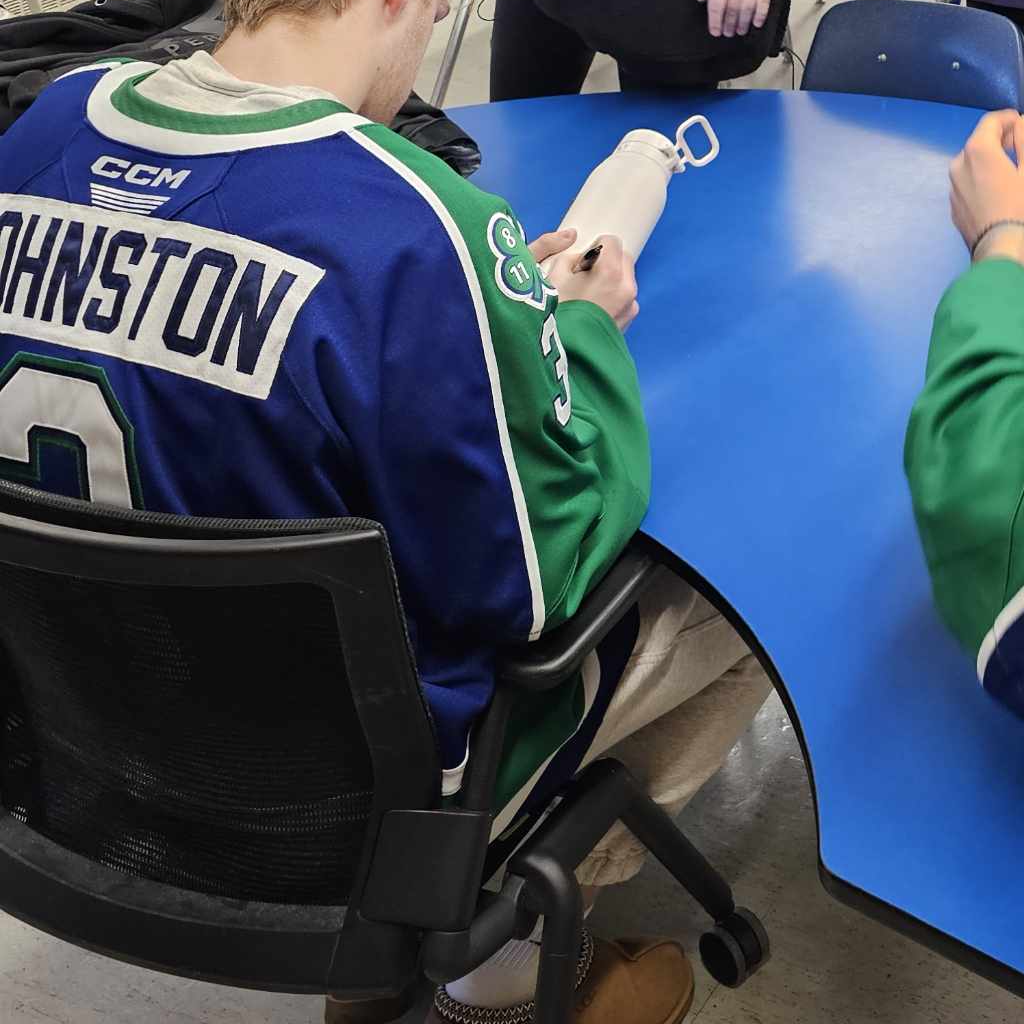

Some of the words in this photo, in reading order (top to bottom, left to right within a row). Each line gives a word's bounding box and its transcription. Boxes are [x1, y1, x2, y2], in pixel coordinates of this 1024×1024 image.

[90, 155, 192, 190] CCM
[501, 226, 517, 249] 8
[509, 261, 530, 285] 11
